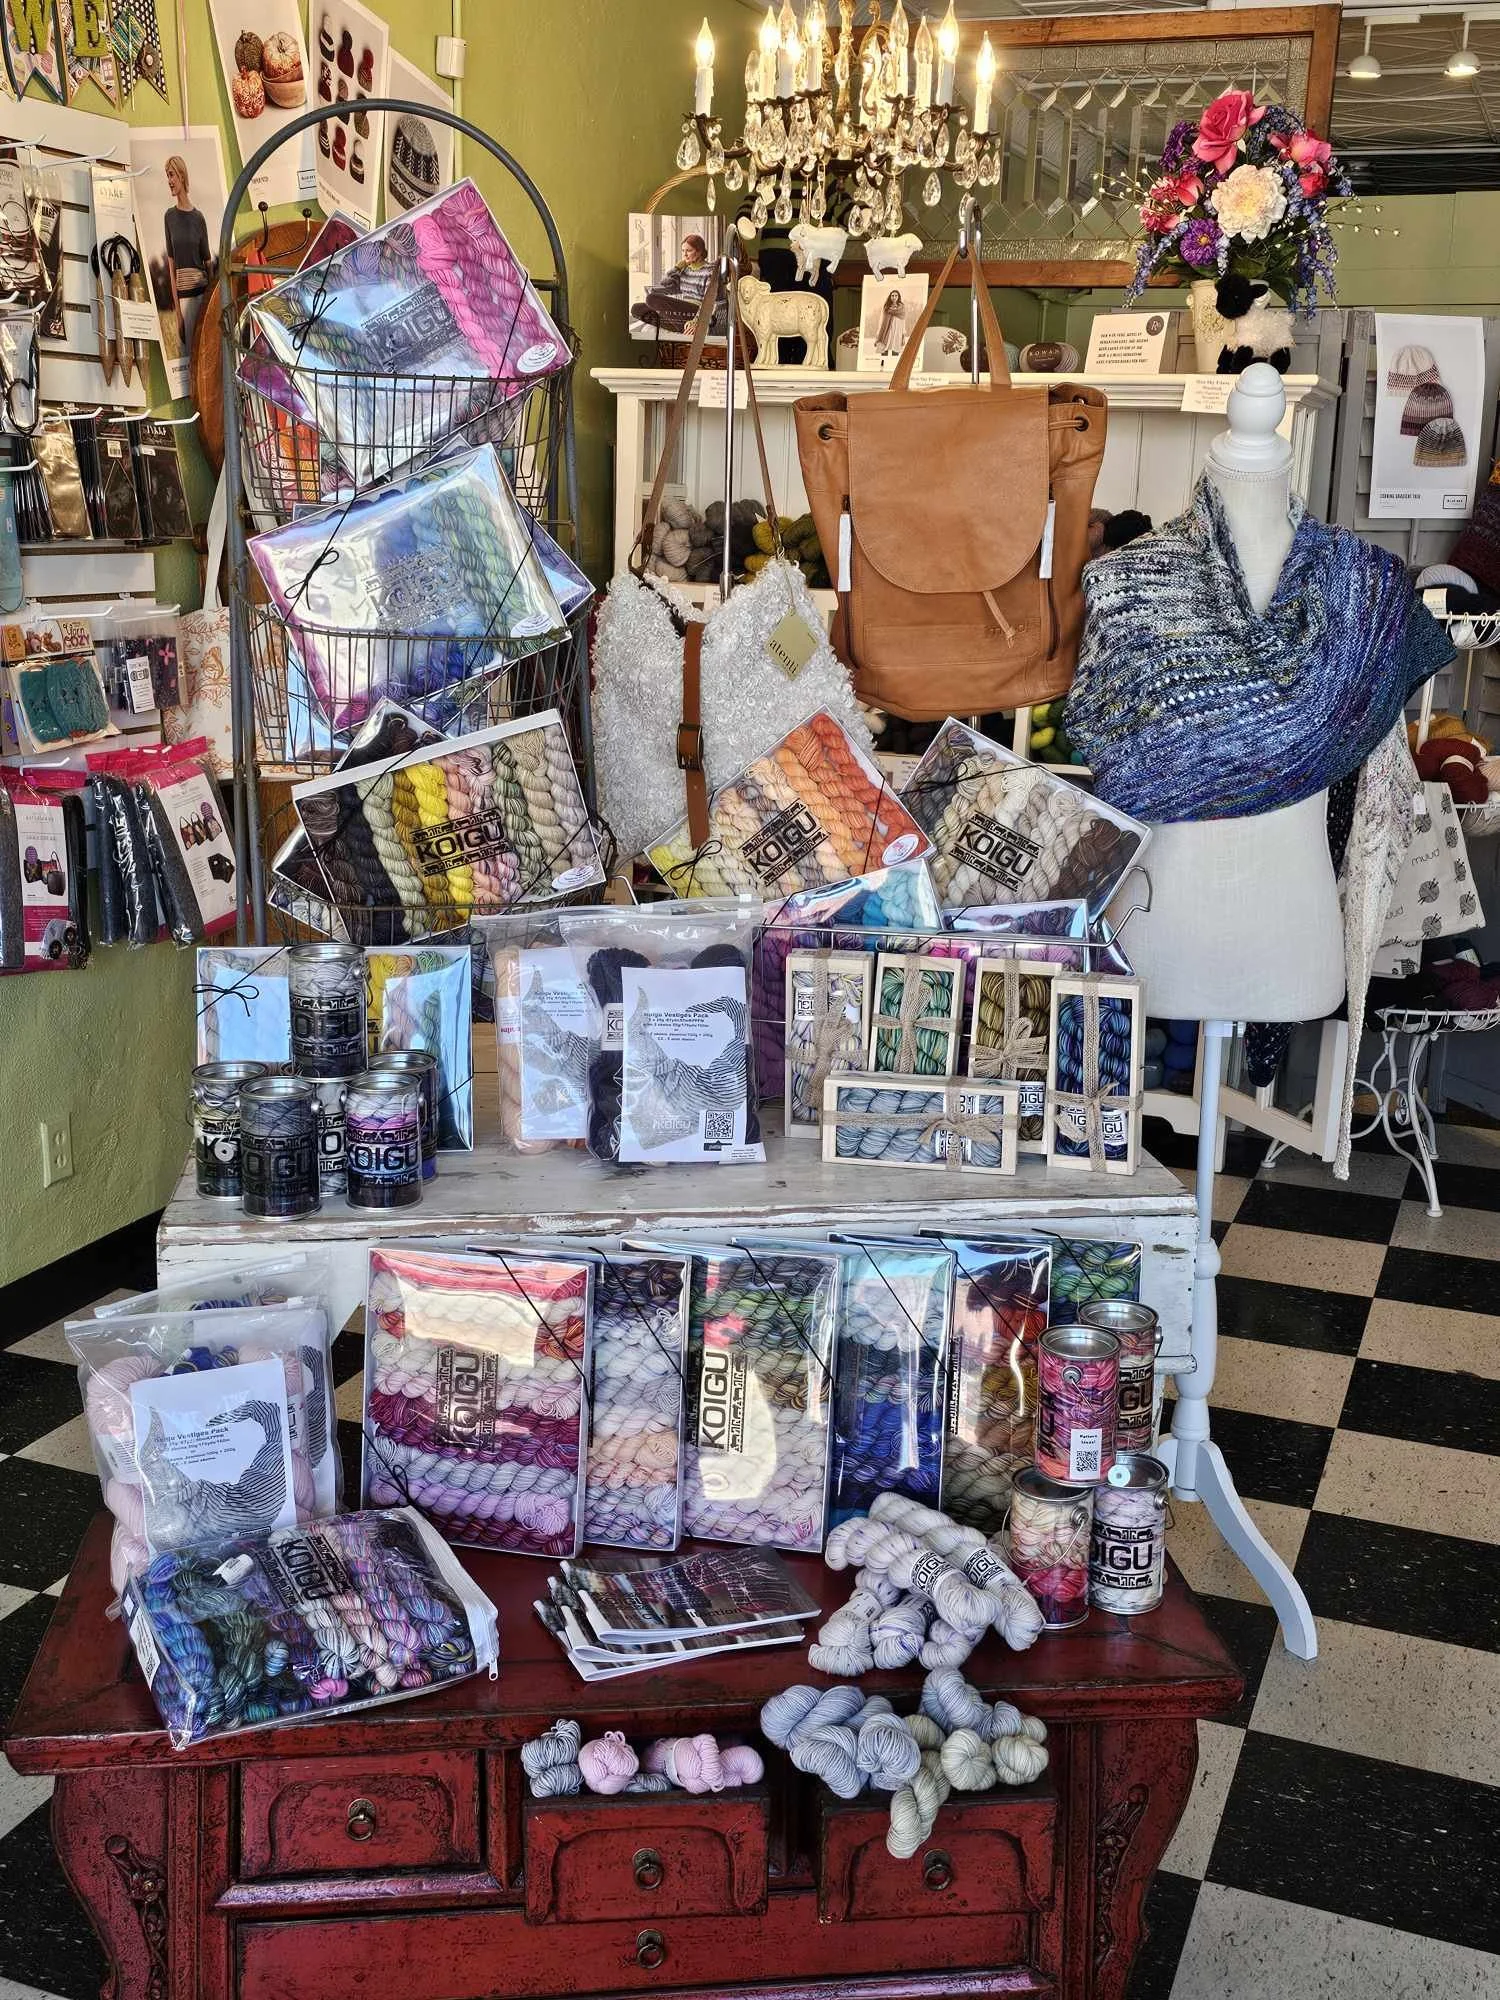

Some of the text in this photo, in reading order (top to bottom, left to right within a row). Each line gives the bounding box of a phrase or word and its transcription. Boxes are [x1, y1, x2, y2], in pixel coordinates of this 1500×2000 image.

[416, 821, 504, 863] KOIGU
[749, 810, 817, 874] KOIGU
[957, 823, 1034, 876] KOIGU
[1020, 1093, 1045, 1103] OIGU
[1102, 1122, 1122, 1133] IGU
[453, 1351, 480, 1449] KOIGU
[700, 1352, 729, 1449] KOIGU
[276, 1539, 335, 1600] KOIGU
[969, 1557, 997, 1584] OIGU
